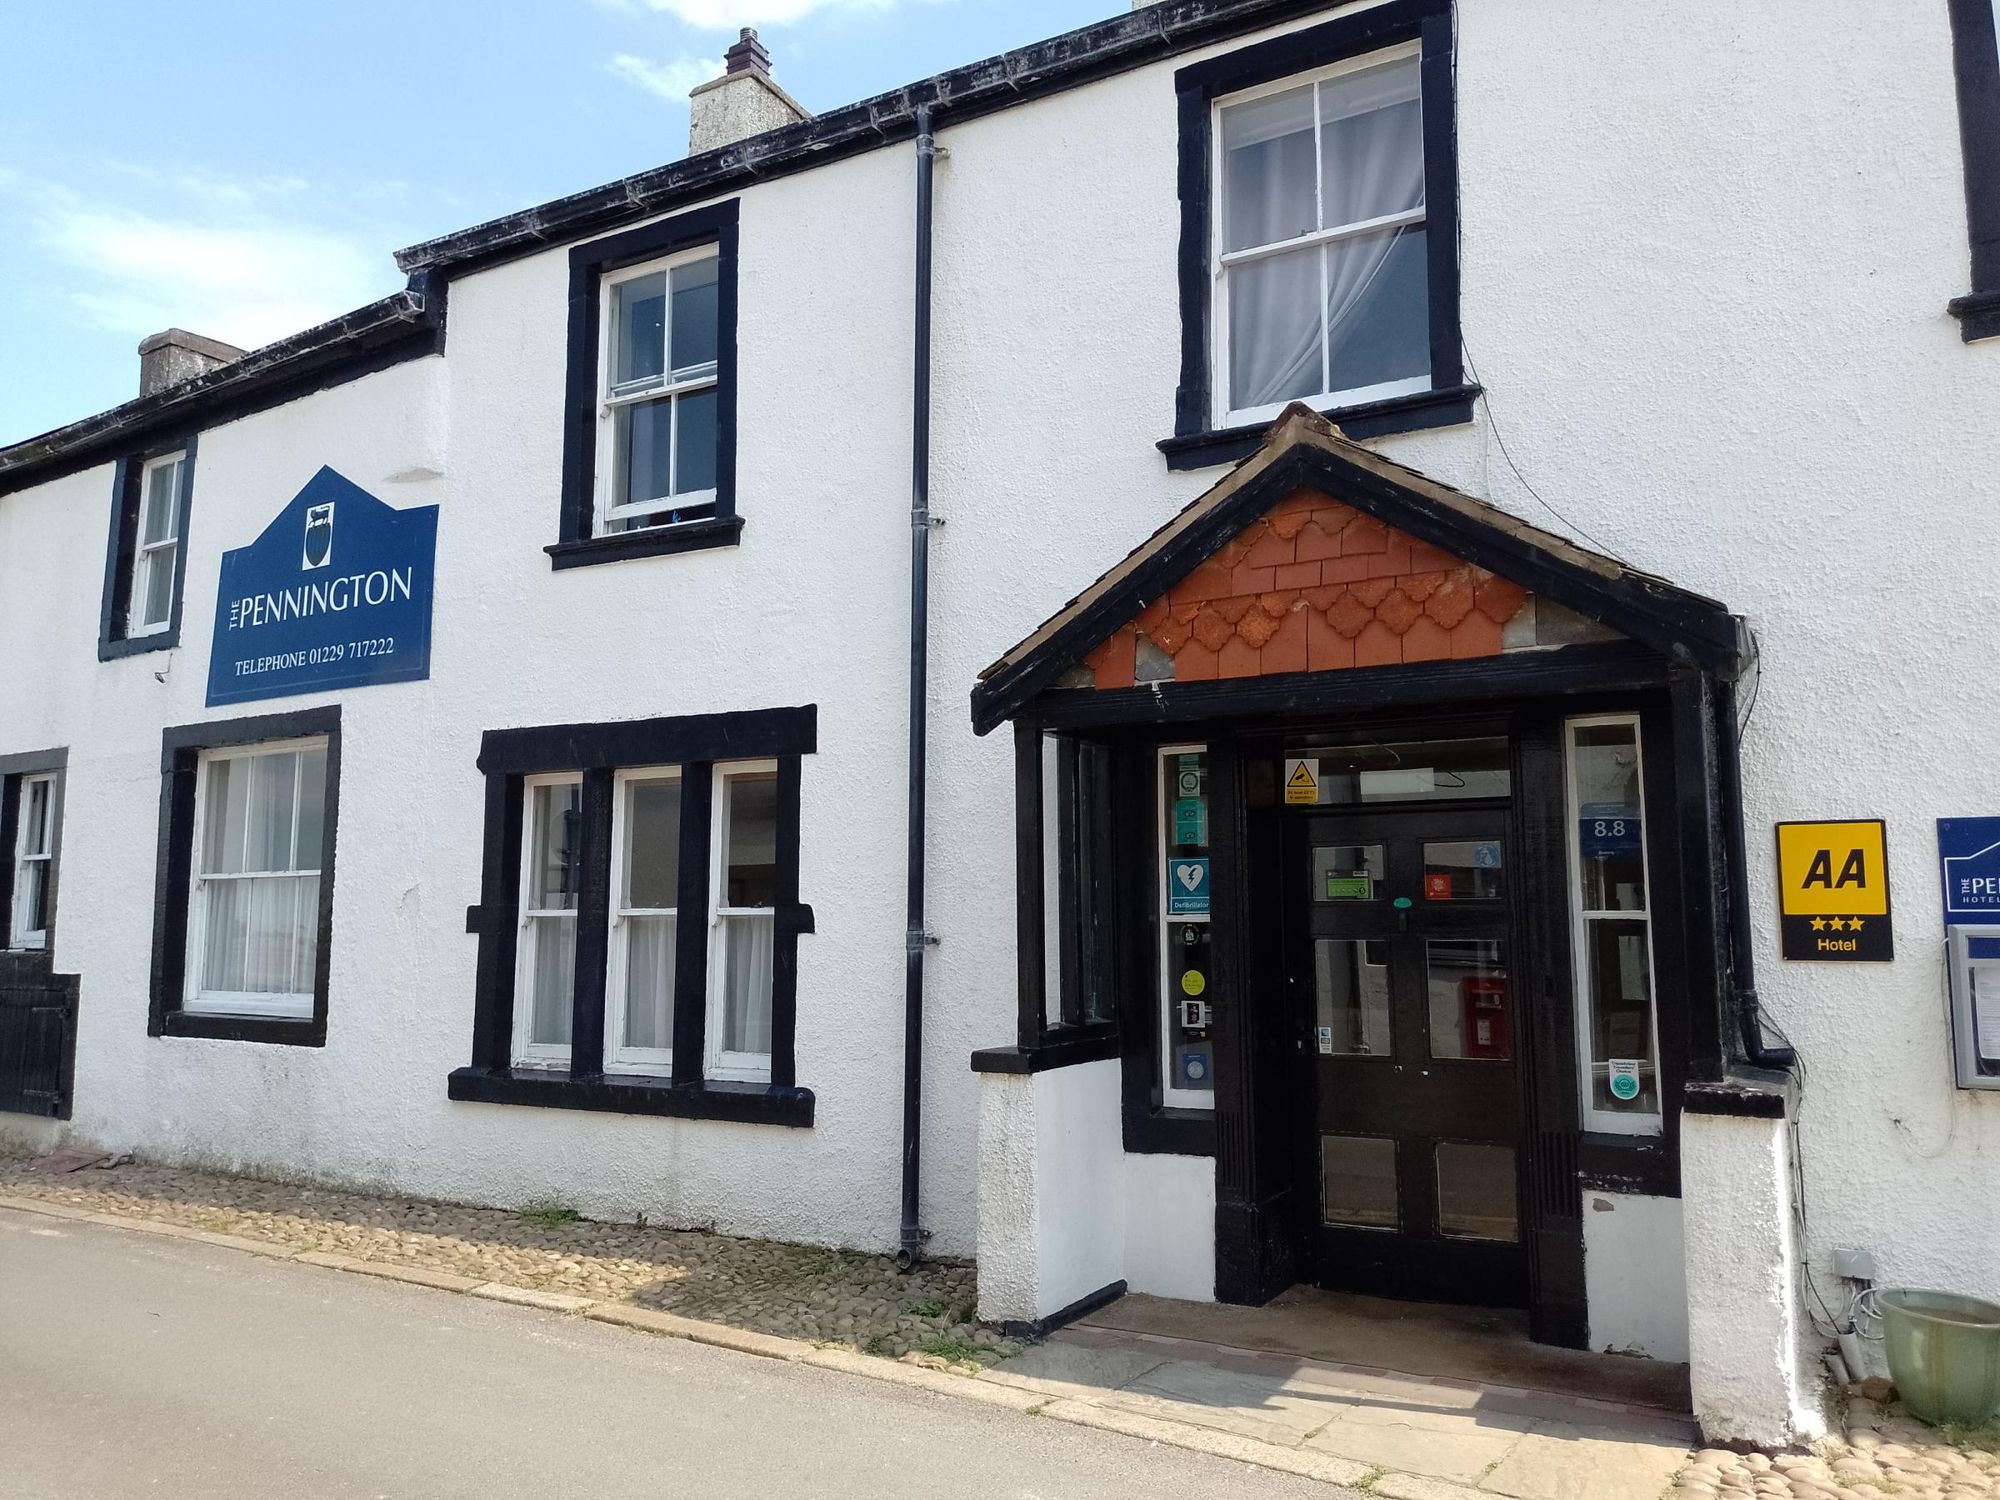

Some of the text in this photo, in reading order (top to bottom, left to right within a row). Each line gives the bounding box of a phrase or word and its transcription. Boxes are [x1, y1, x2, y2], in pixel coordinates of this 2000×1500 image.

[229, 566, 412, 631] THE PENNINGTON
[235, 637, 394, 676] TELEPHONE 01229 717222
[1594, 820, 1626, 837] 8.8
[1801, 848, 1866, 889] AA
[1960, 878, 1970, 894] THE
[1817, 938, 1856, 951] Hotel
